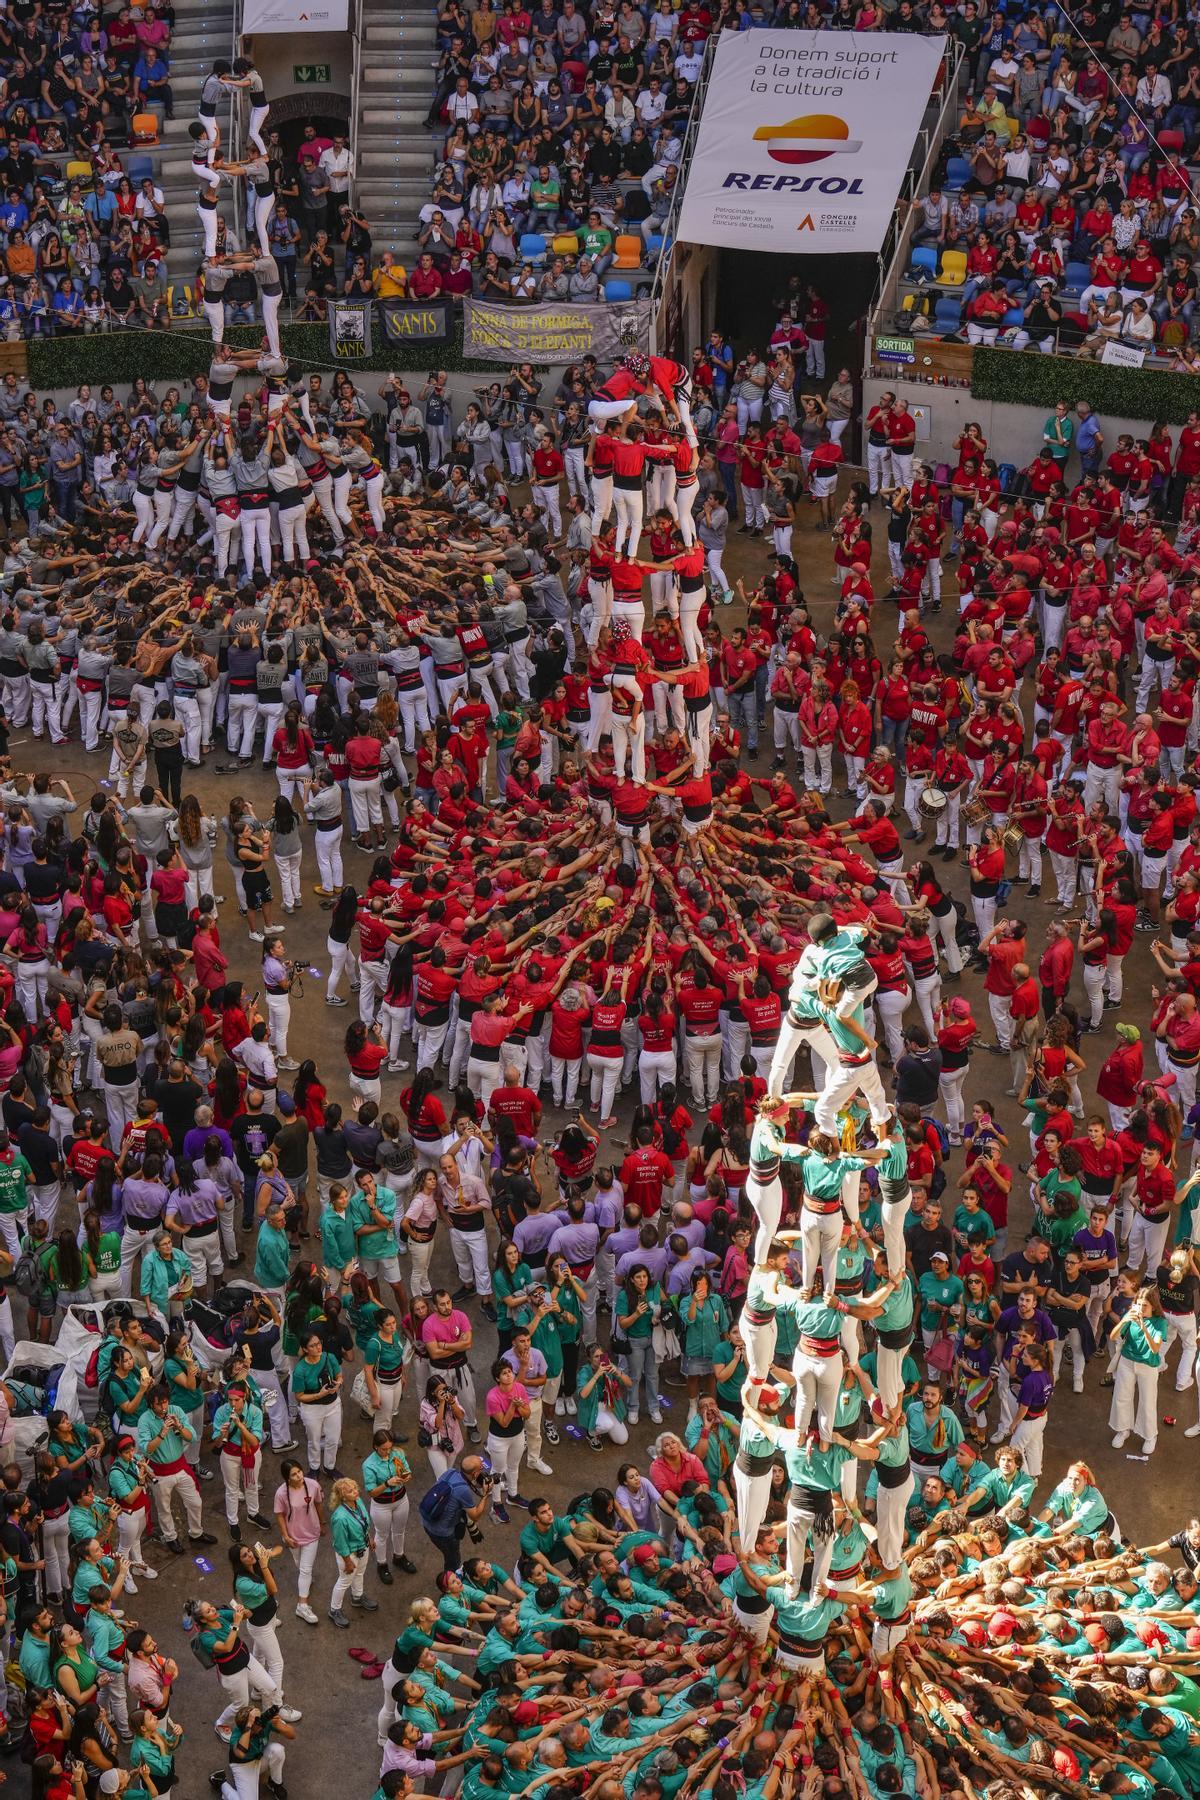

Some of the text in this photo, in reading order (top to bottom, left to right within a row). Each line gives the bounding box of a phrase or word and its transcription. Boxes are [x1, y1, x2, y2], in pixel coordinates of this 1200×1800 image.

[759, 46, 899, 65] Donem suport
[754, 63, 881, 81] a la tradició i
[750, 79, 843, 97] la cultura
[721, 172, 864, 195] REPSOL
[391, 311, 438, 336] SANTS
[511, 314, 528, 329] DE
[336, 341, 366, 357] SANTS
[877, 339, 912, 351] SORTIDA
